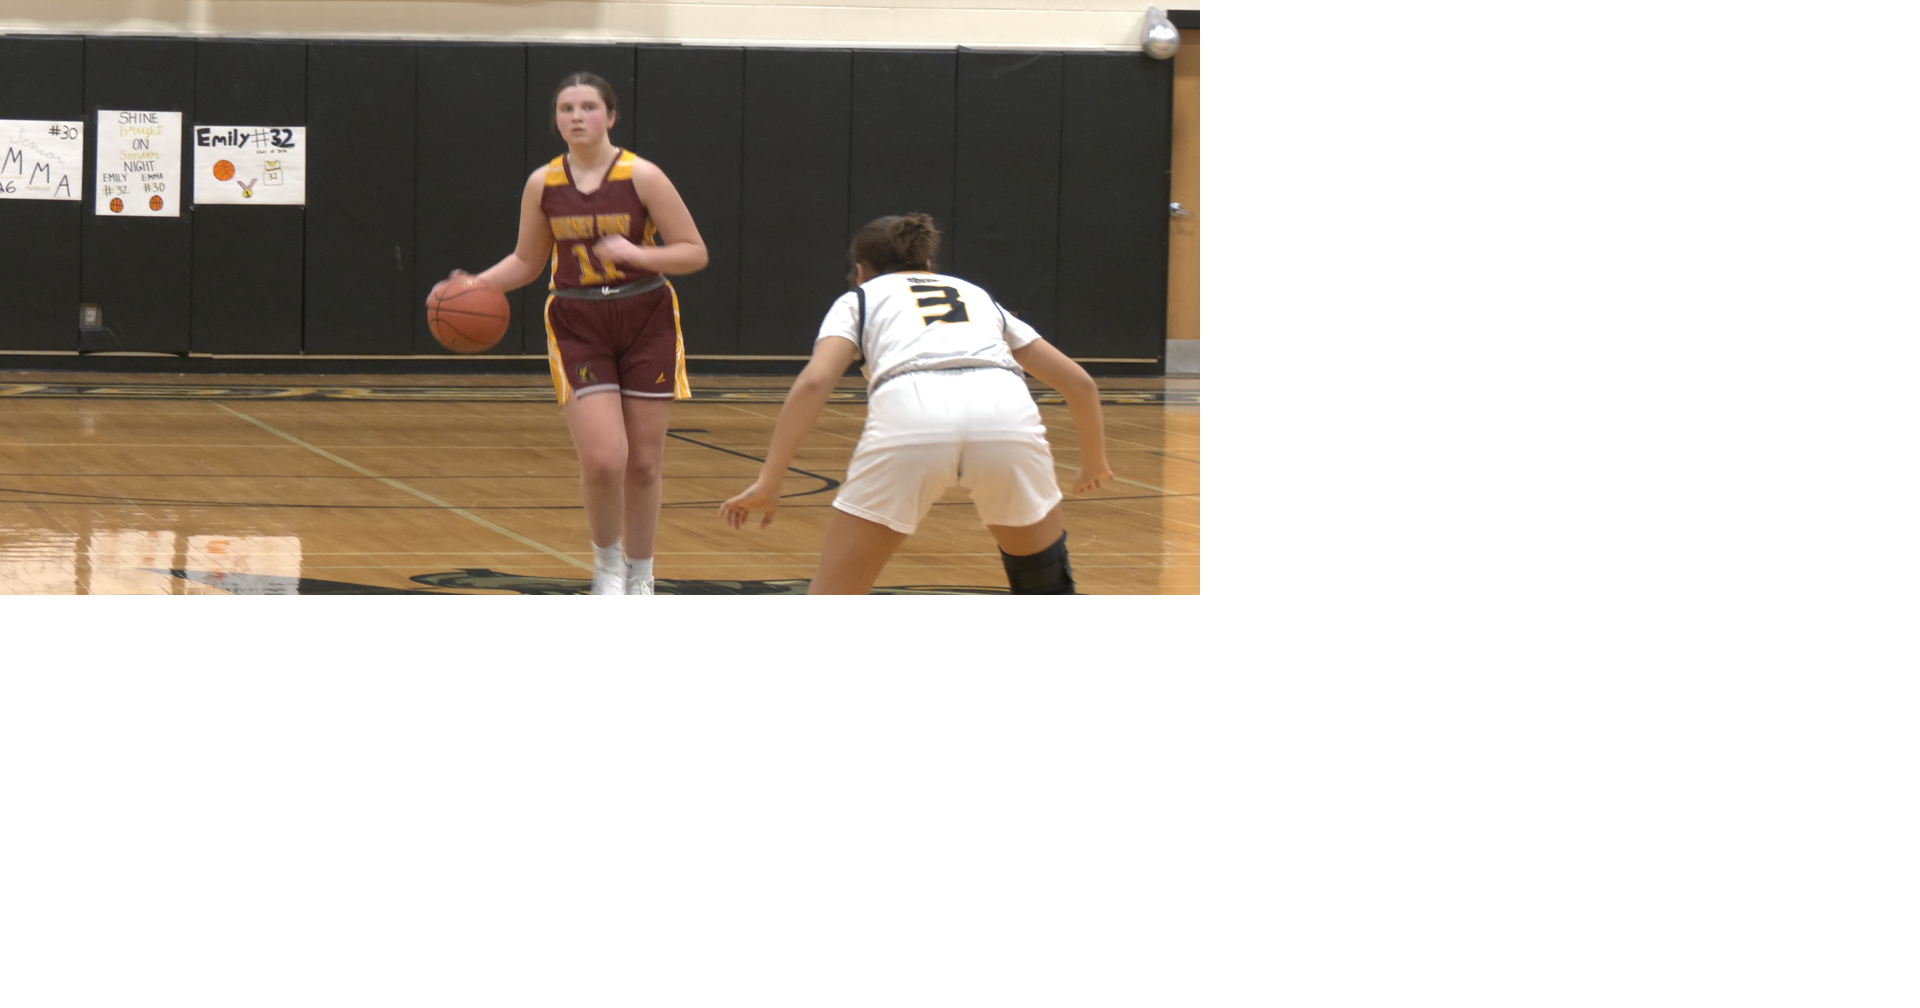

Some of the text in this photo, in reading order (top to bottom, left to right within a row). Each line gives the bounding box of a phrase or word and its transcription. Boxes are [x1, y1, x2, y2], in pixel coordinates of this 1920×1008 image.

[118, 112, 158, 124] SHINE
[48, 125, 78, 140] #30
[196, 127, 295, 149] Emily #32
[132, 139, 149, 151] ON
[123, 161, 155, 172] NIGHT
[103, 173, 164, 183] EMILY EMMA
[268, 172, 279, 181] 32
[102, 182, 166, 196] #32 #30
[907, 284, 972, 328] 3
